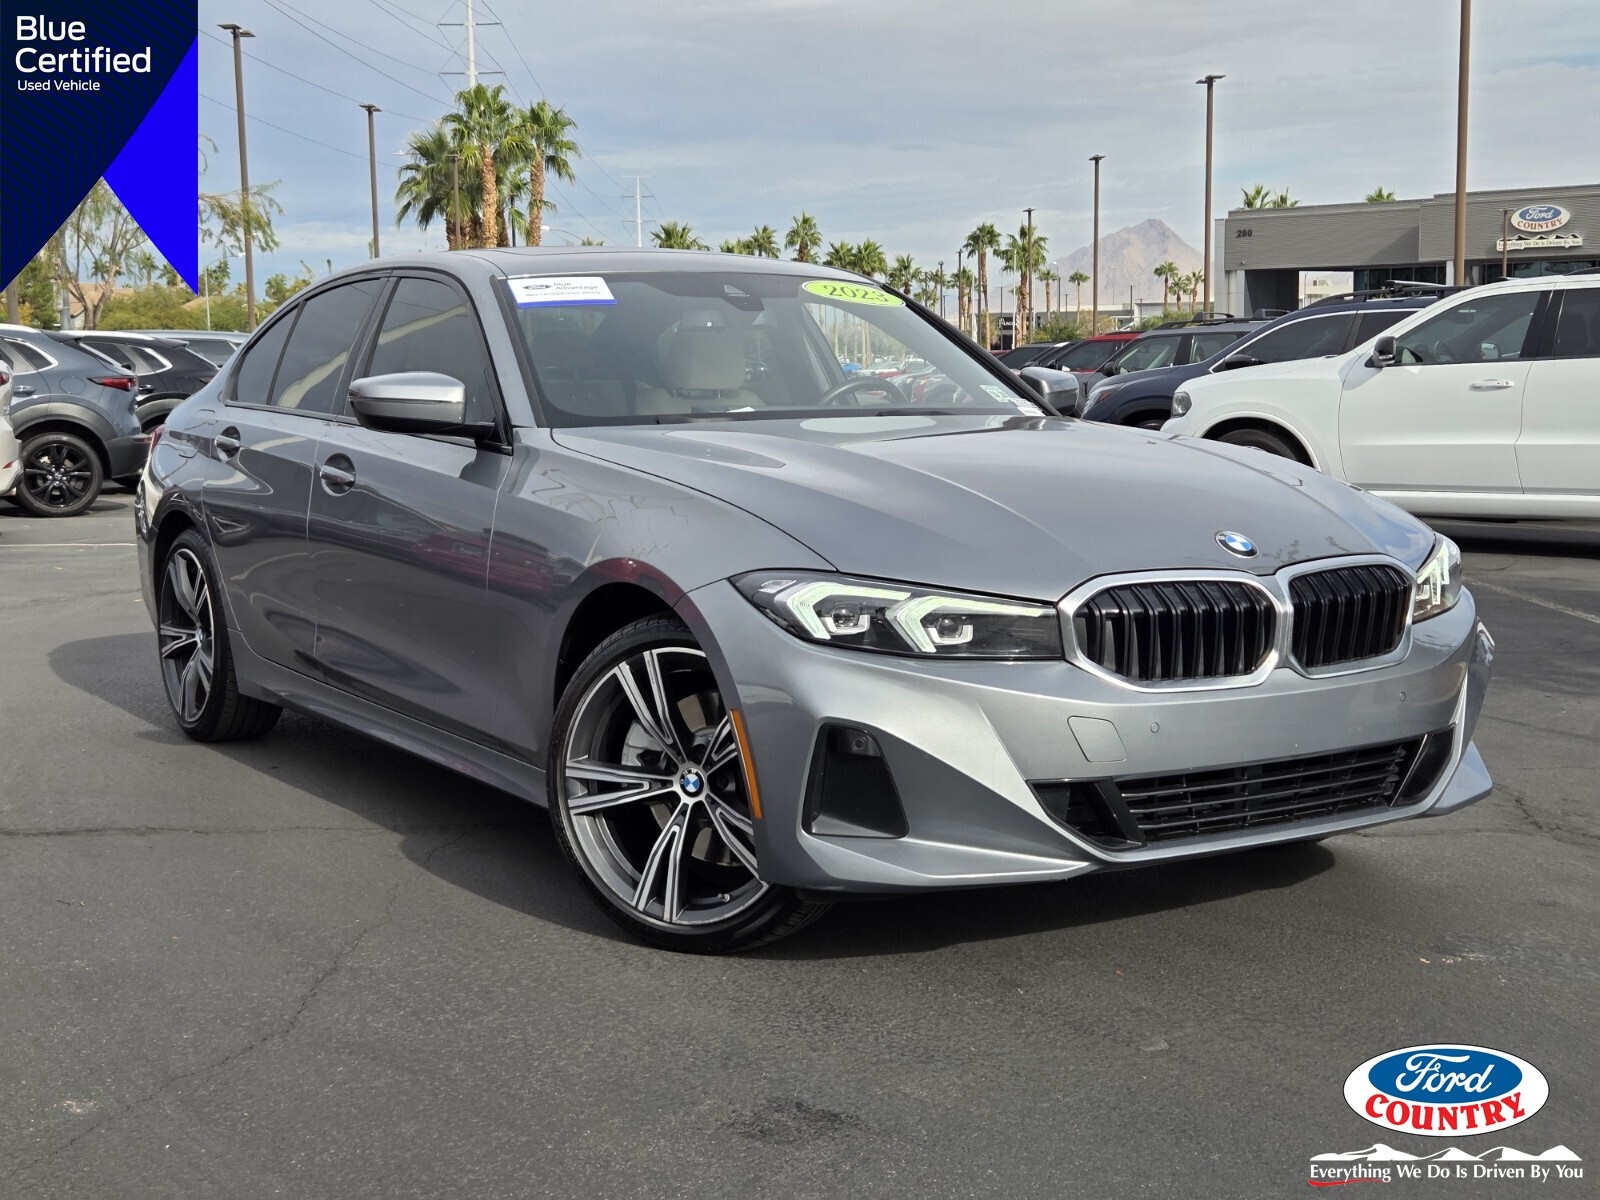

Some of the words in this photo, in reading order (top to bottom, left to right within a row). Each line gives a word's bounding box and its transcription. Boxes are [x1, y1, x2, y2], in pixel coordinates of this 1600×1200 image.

[1525, 207, 1554, 220] Ford
[1517, 217, 1564, 230] COUNTRY
[1236, 229, 1253, 238] 280
[822, 284, 889, 303] 2023
